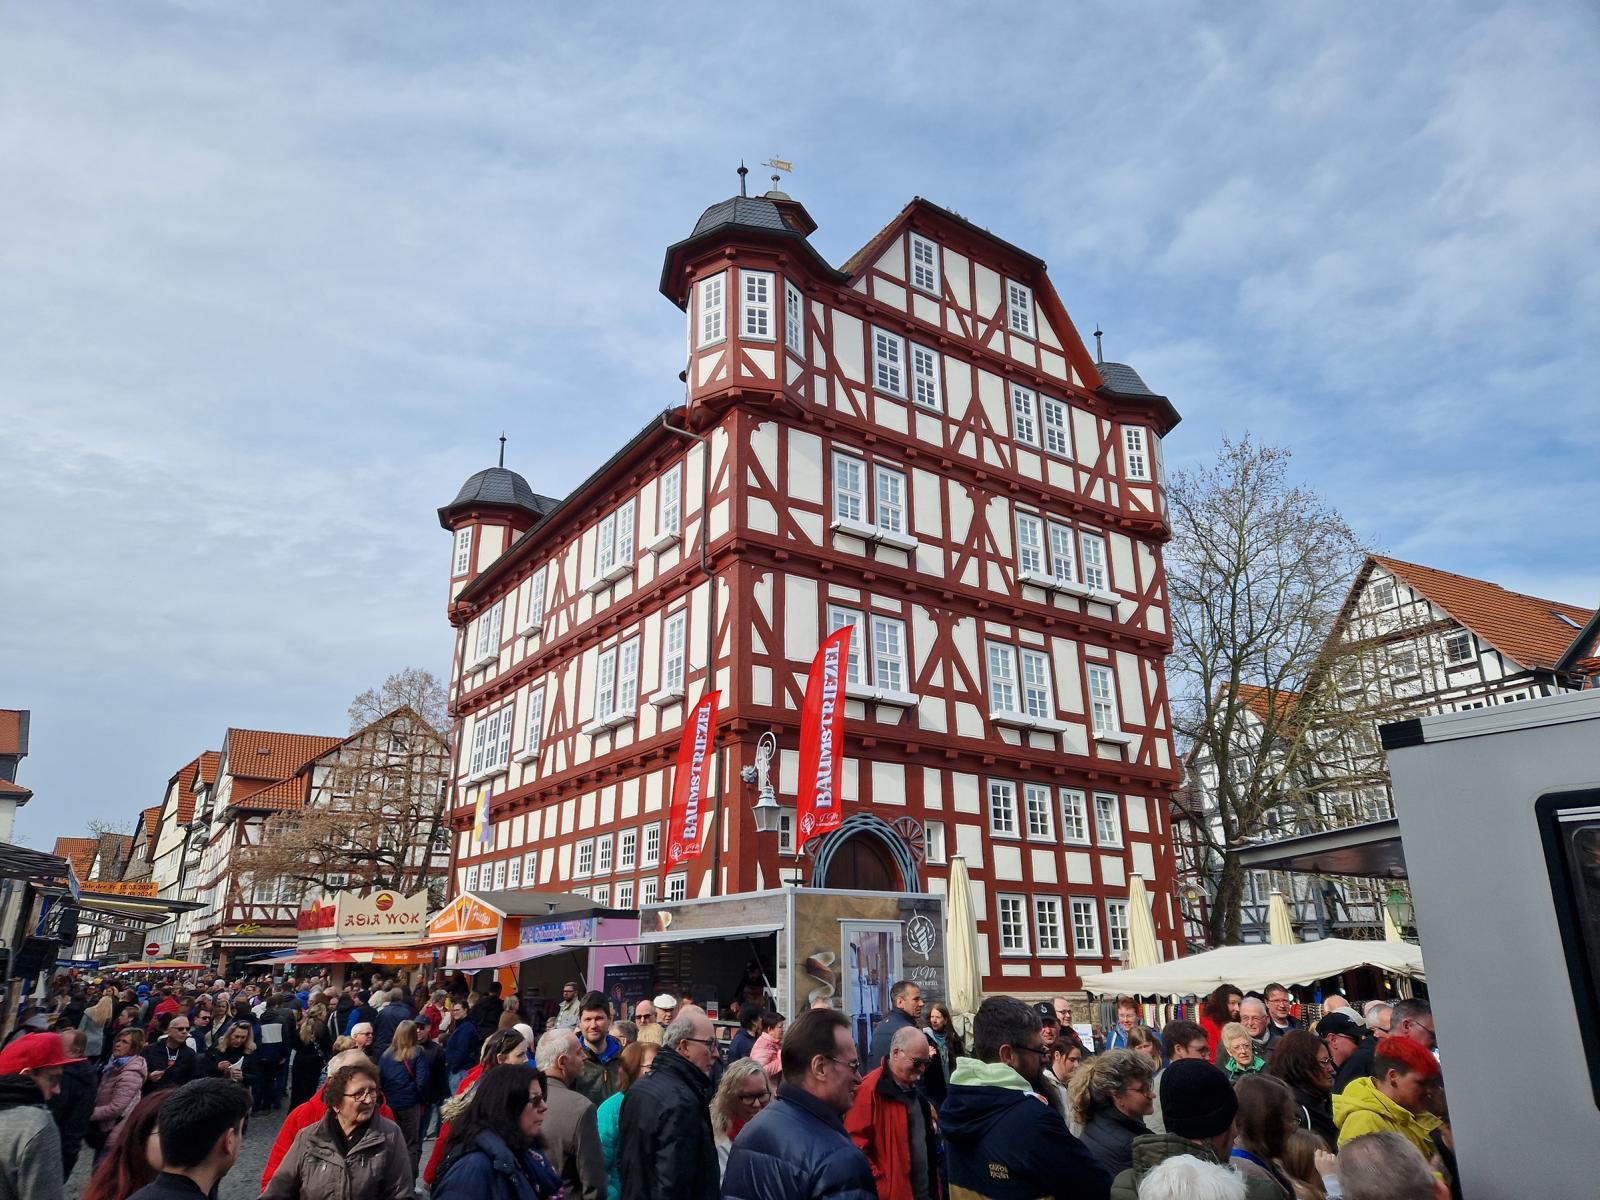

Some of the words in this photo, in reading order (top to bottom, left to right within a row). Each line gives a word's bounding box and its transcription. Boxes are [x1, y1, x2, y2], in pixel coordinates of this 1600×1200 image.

[683, 702, 712, 841] BAUMSTRIEZEL
[815, 640, 841, 809] BAUMSTRIEZEL
[344, 913, 381, 927] ASIA
[385, 912, 420, 925] WOK
